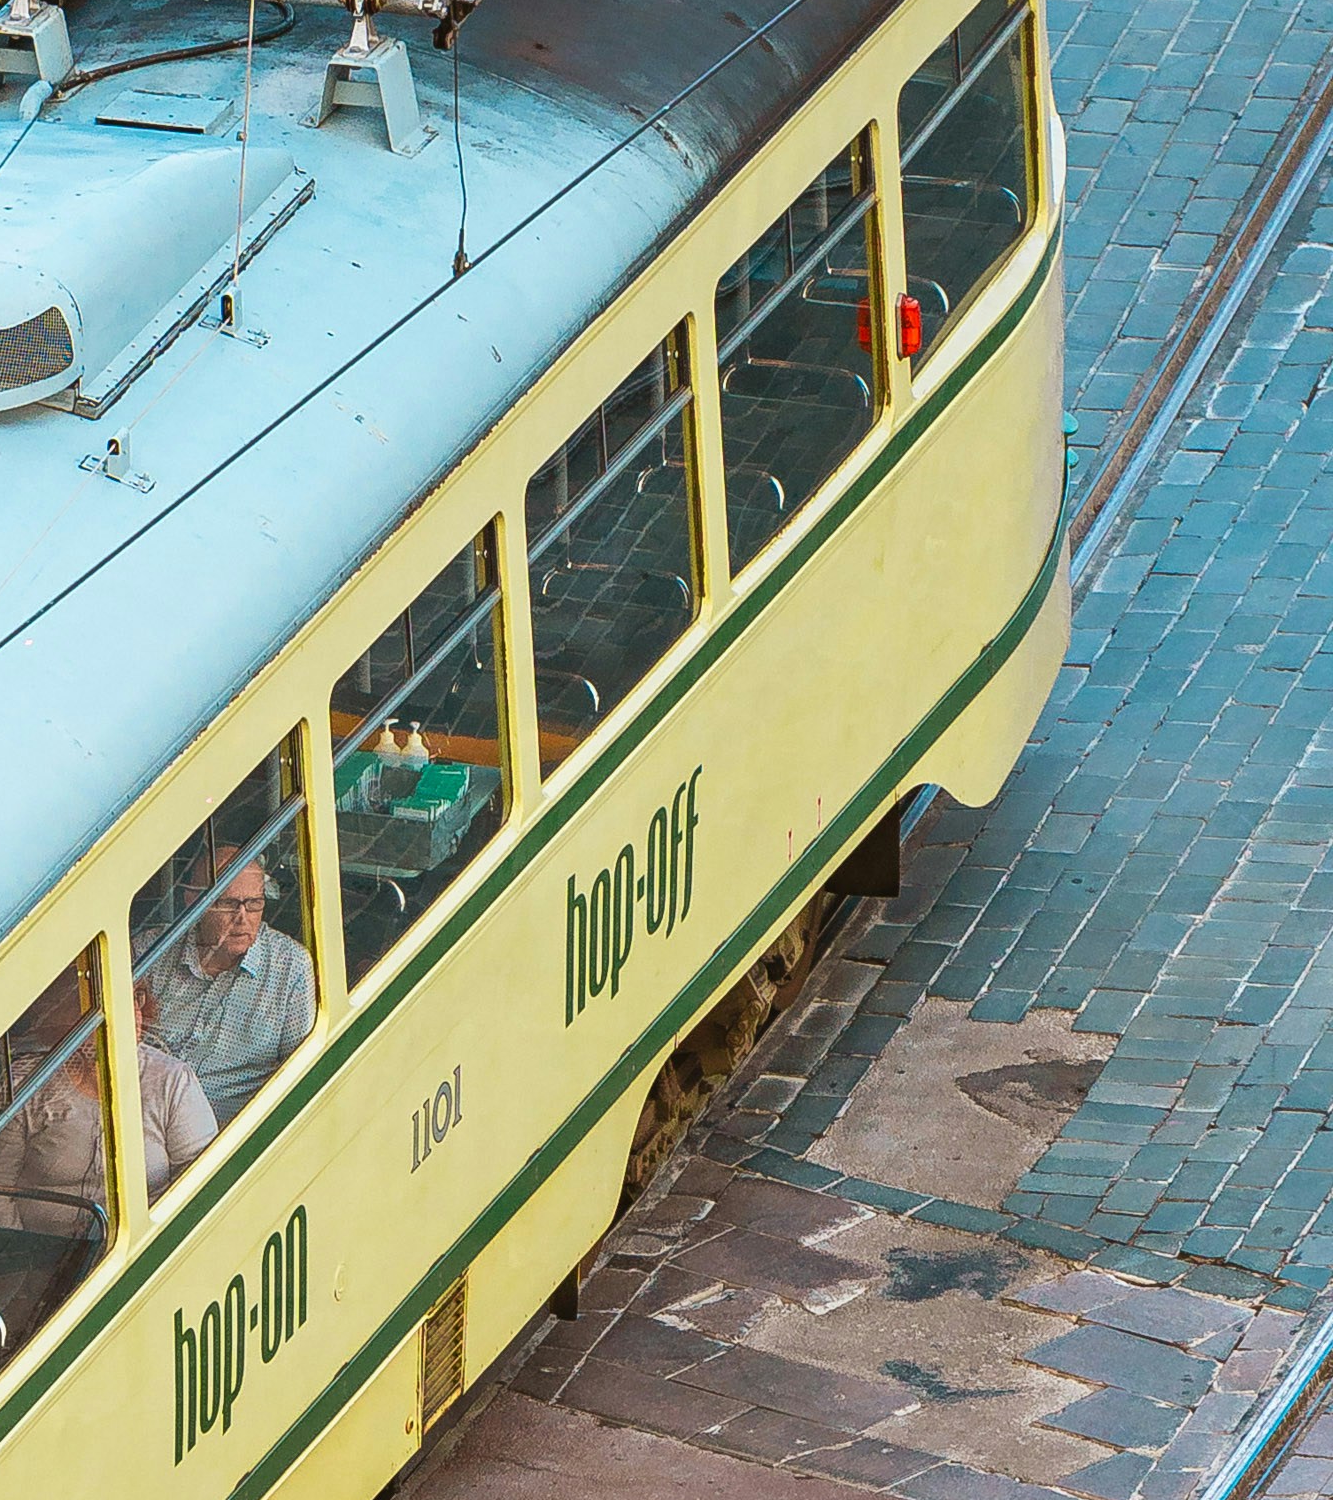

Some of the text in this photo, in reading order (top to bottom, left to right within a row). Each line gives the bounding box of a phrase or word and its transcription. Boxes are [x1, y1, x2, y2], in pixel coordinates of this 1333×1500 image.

[563, 763, 703, 1028] hop-off
[410, 1064, 463, 1174] 1101
[174, 1203, 308, 1467] hop-on
